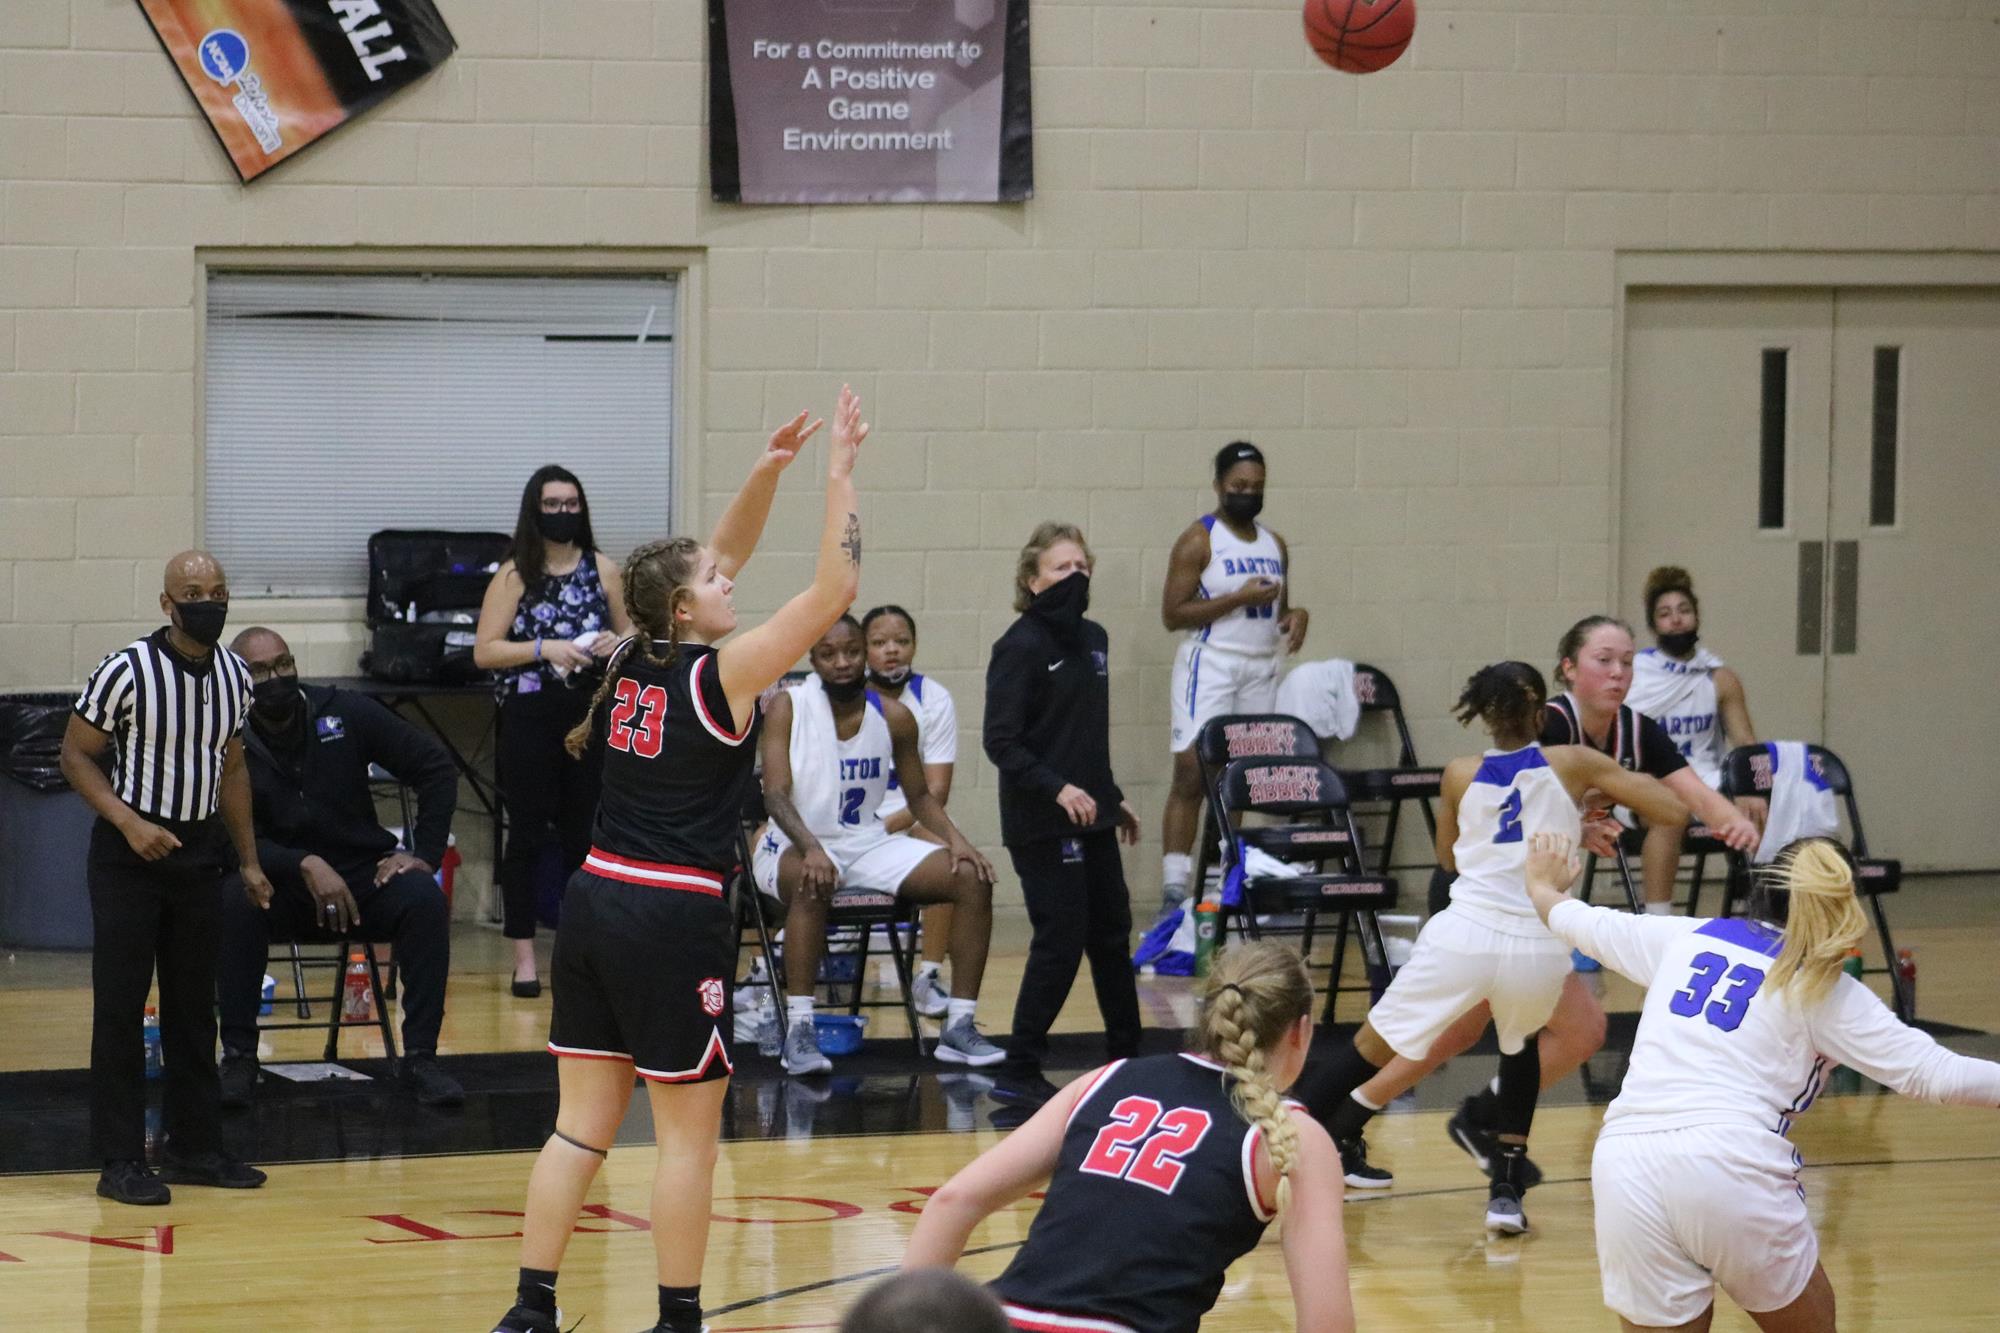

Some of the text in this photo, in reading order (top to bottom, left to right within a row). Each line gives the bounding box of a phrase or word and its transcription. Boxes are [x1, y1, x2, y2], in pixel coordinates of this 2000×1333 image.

[753, 39, 981, 59] For a Commitment to
[801, 66, 935, 90] A Positive
[828, 97, 910, 120] Game
[783, 127, 952, 151] Environment
[607, 677, 667, 759] 23
[1227, 737, 1296, 758] ABBEY
[1244, 765, 1319, 785] BELMONT
[1249, 782, 1321, 804] ABBEY
[838, 786, 866, 825] 2
[1492, 787, 1523, 844] 2
[1668, 951, 1765, 1032] 33
[1079, 1095, 1212, 1195] 22
